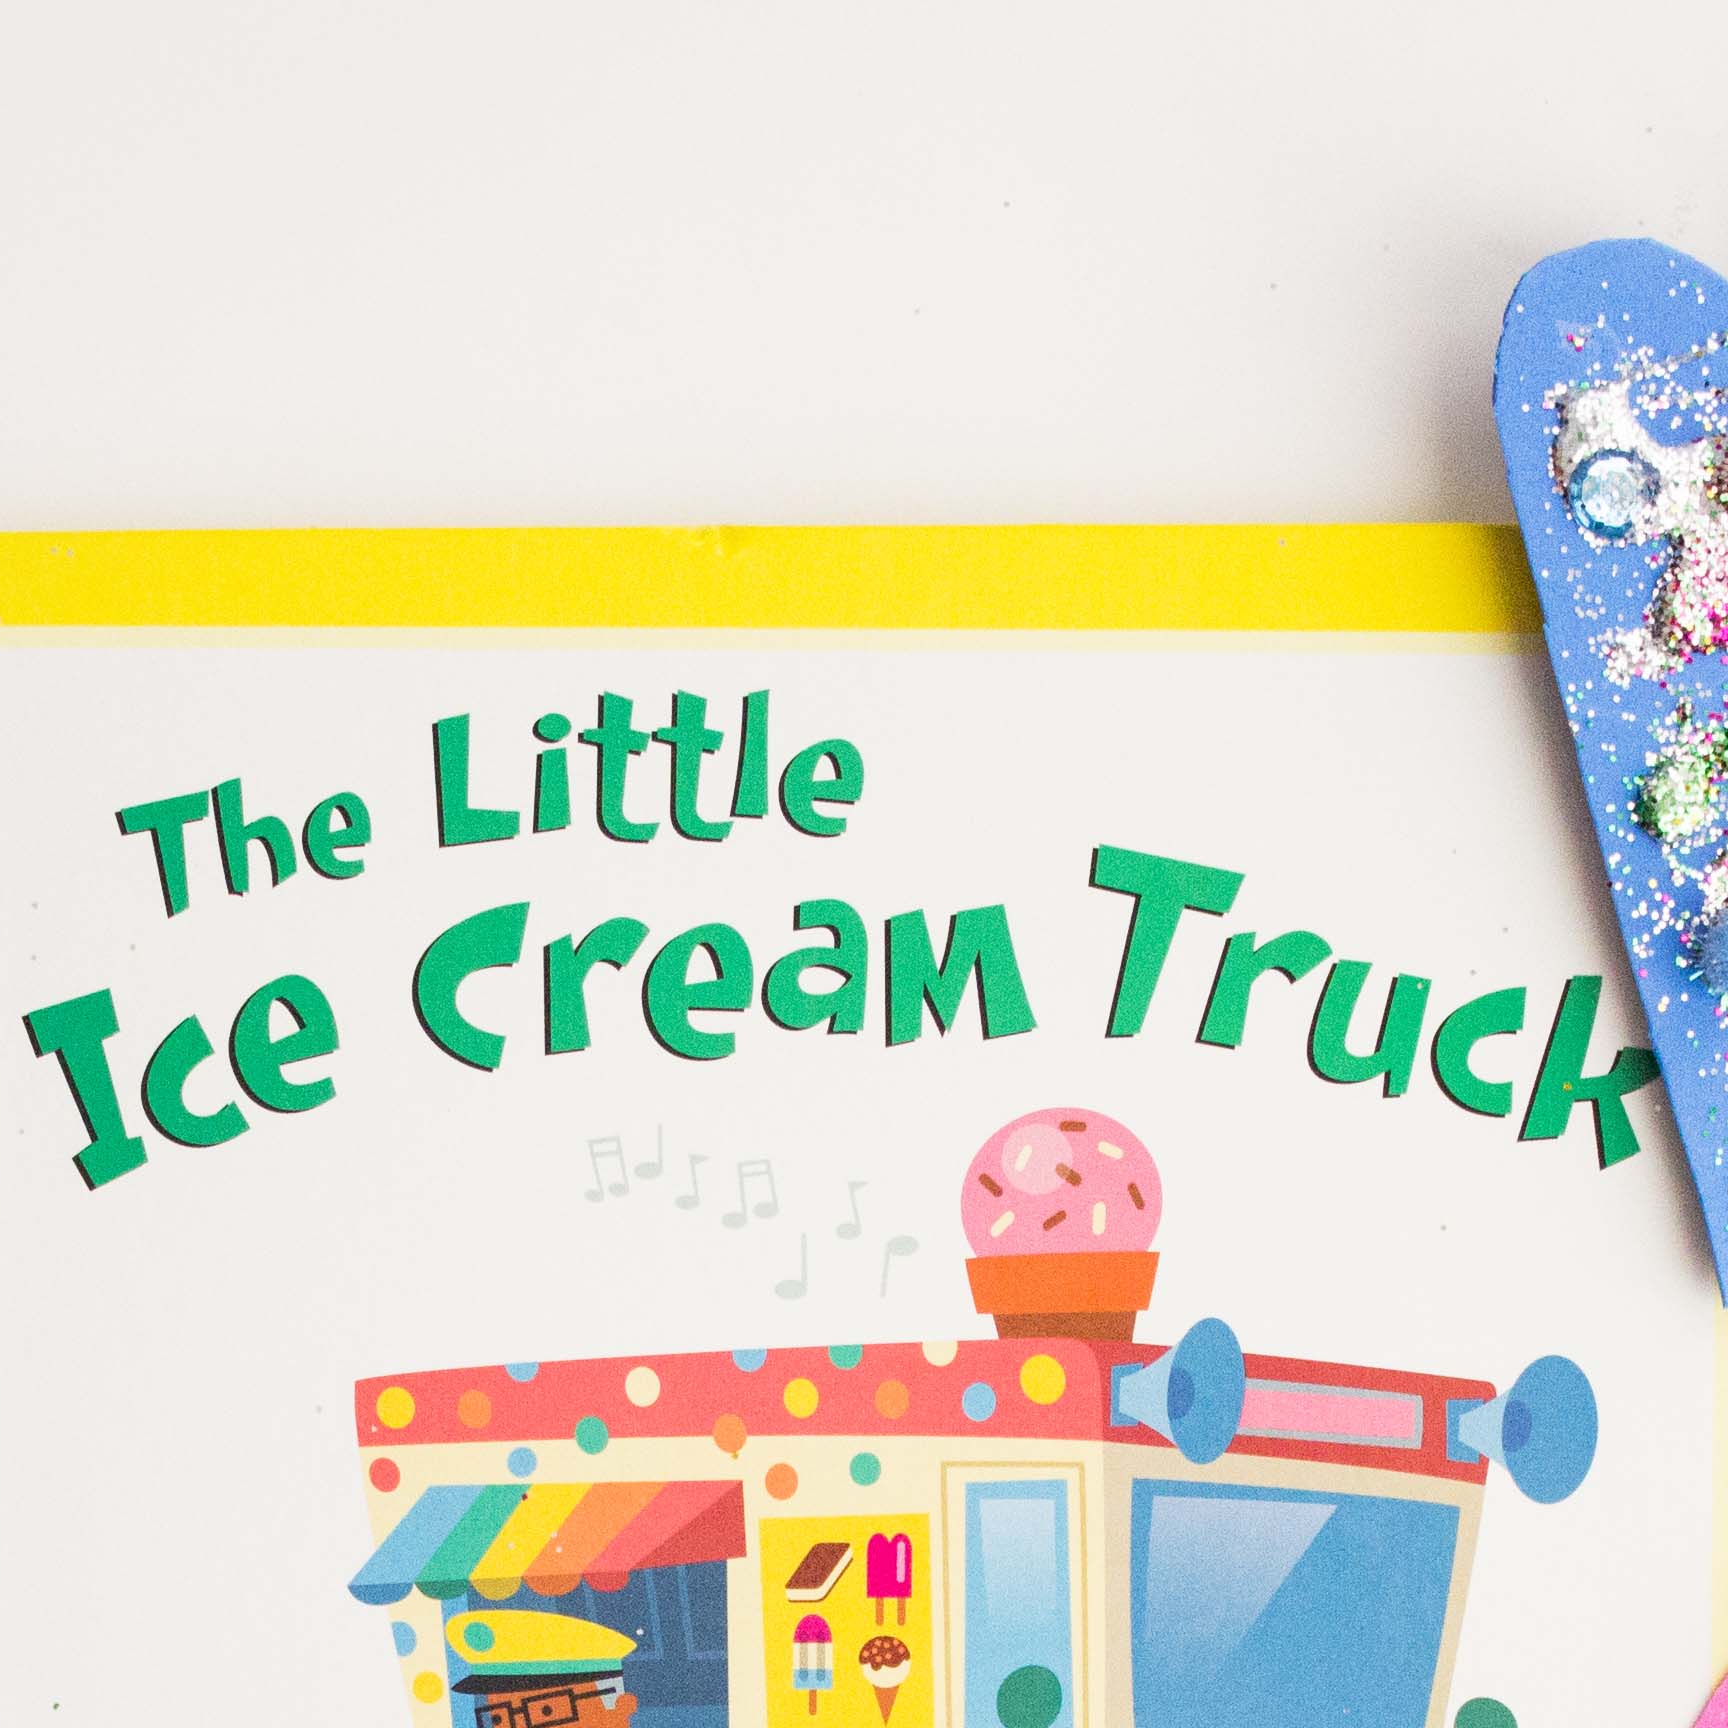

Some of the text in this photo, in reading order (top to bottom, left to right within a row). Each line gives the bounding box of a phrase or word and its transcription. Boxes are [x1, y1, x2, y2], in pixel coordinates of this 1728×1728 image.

[116, 689, 865, 916] The Little
[23, 973, 339, 1189] Ice
[1089, 843, 1659, 1169] Truck
